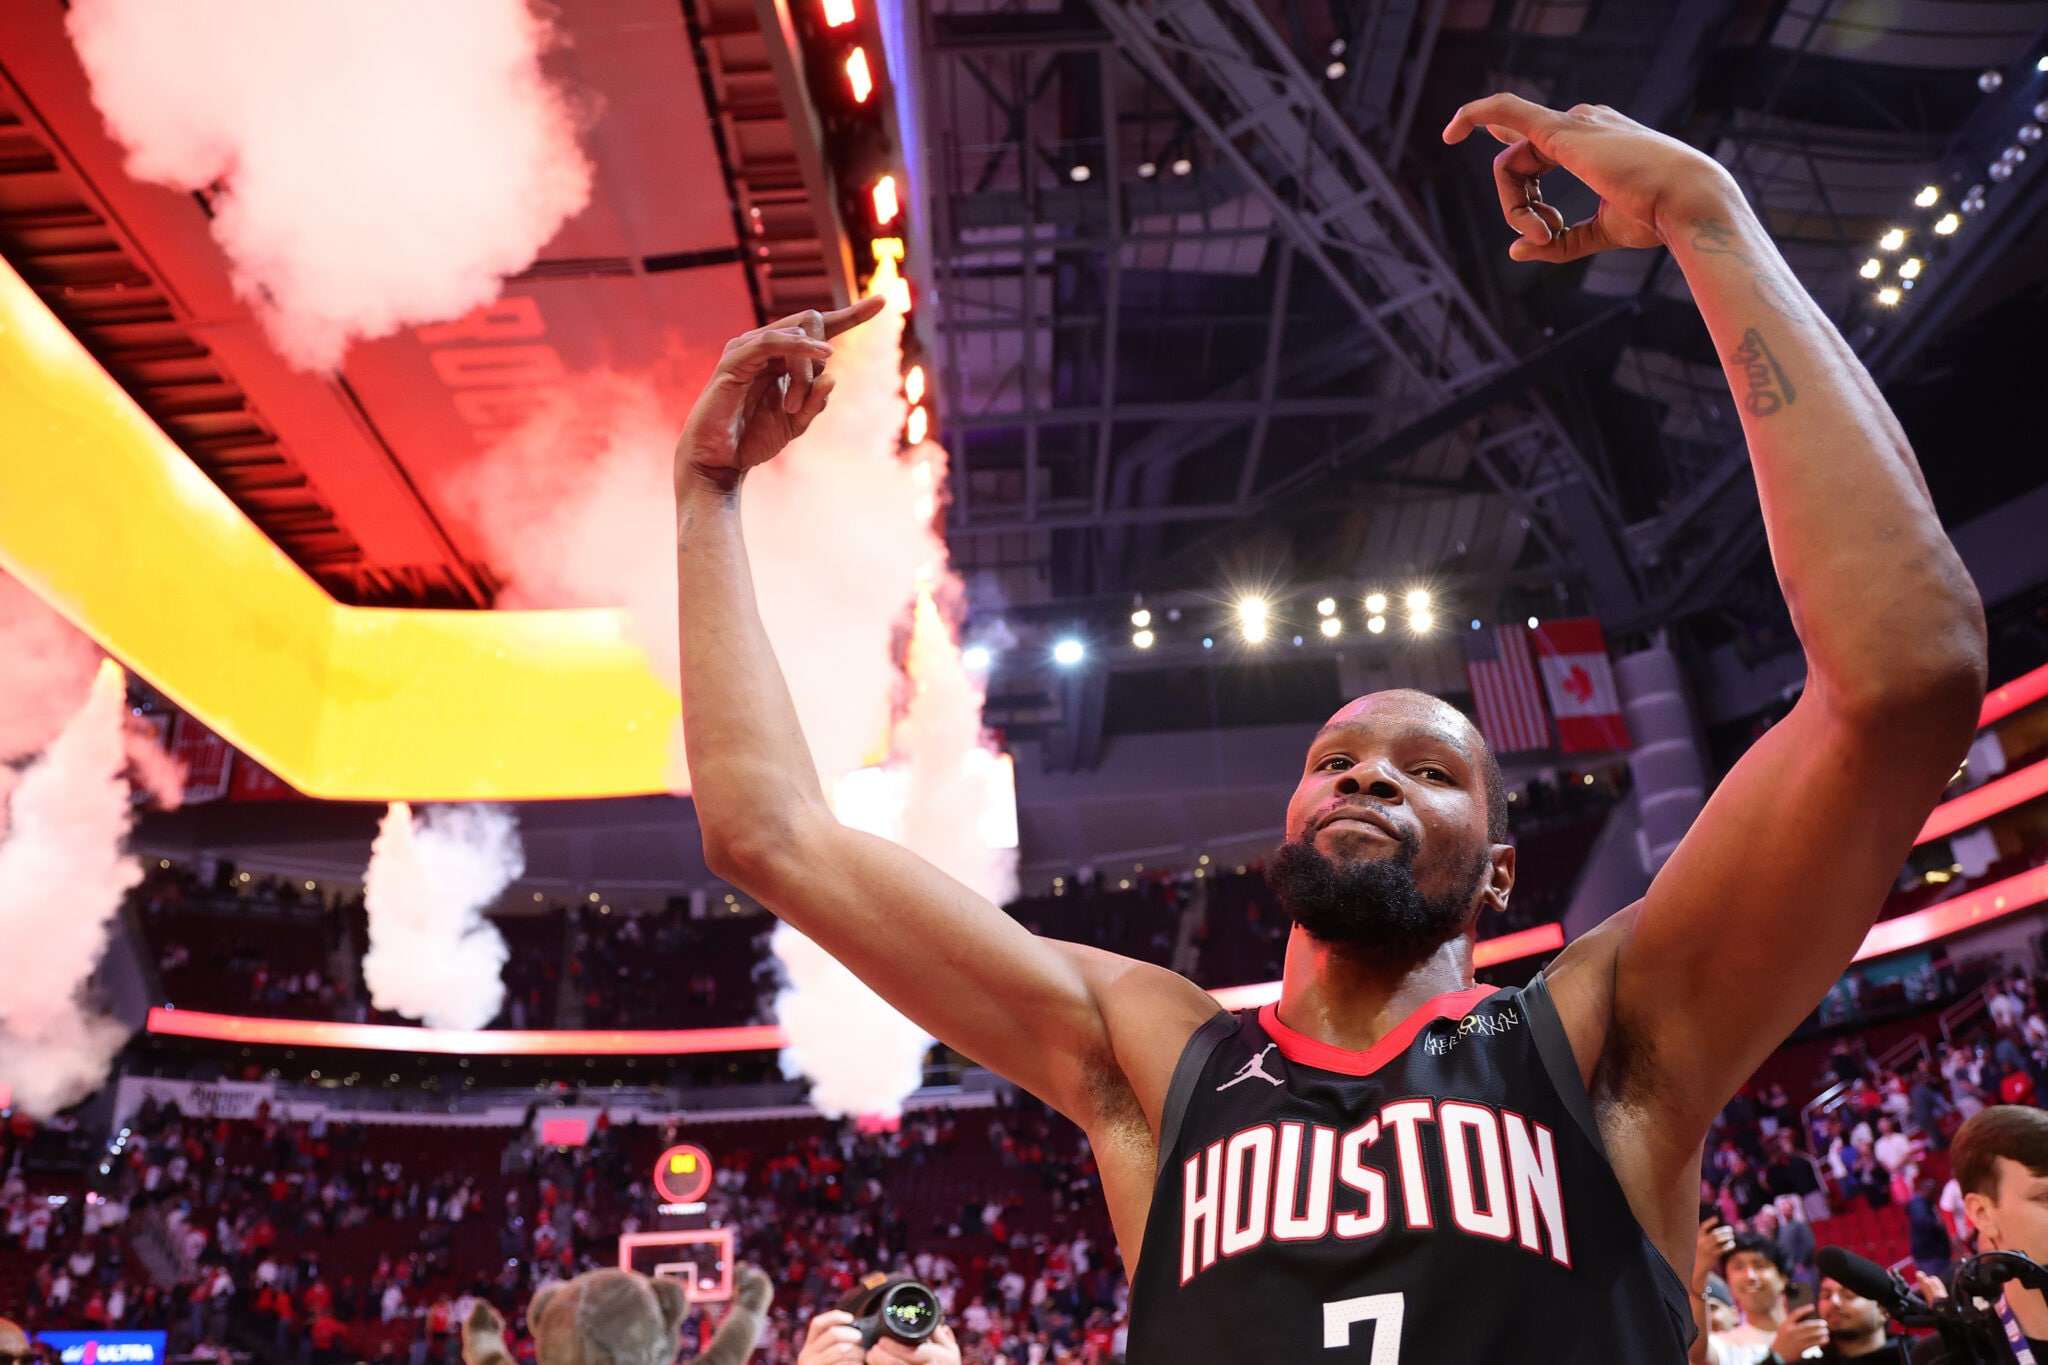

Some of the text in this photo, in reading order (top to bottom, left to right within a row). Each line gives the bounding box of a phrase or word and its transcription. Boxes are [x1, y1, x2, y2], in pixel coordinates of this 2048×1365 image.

[1424, 1008, 1518, 1050] MEORIAL
[1180, 1099, 1572, 1287] HOUSTON
[1322, 1291, 1405, 1365] 7
